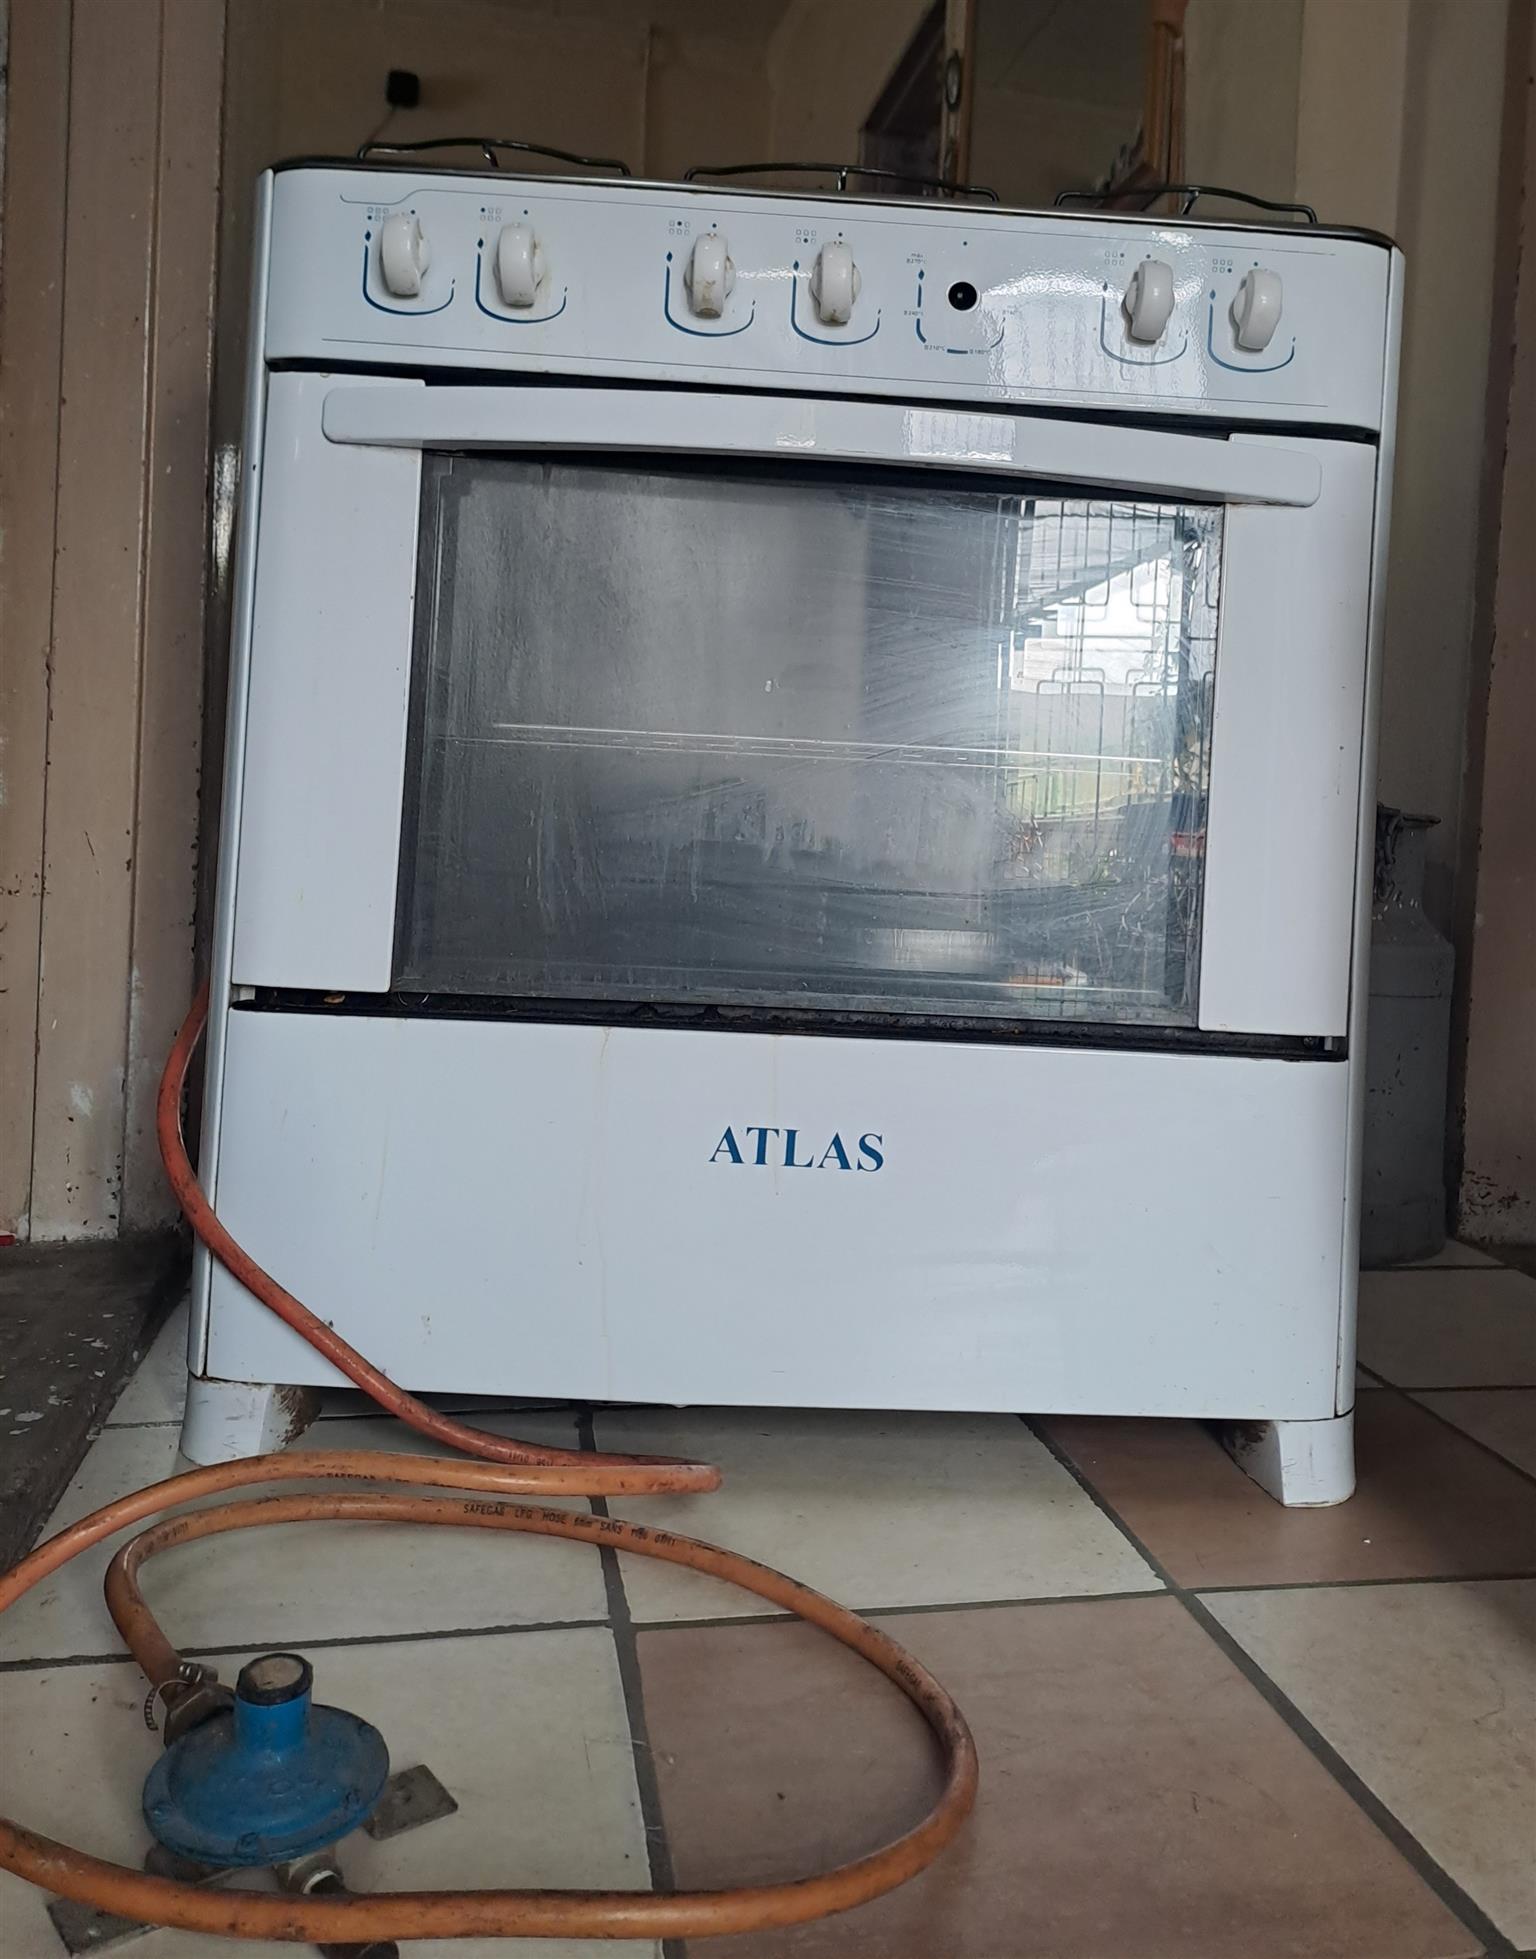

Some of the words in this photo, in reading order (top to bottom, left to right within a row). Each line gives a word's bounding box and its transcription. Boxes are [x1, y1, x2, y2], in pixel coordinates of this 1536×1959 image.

[708, 1125, 885, 1173] ATLAS
[463, 1503, 505, 1517] SAFEGAS
[543, 1511, 567, 1525] HOSE
[600, 1520, 624, 1536] SANS
